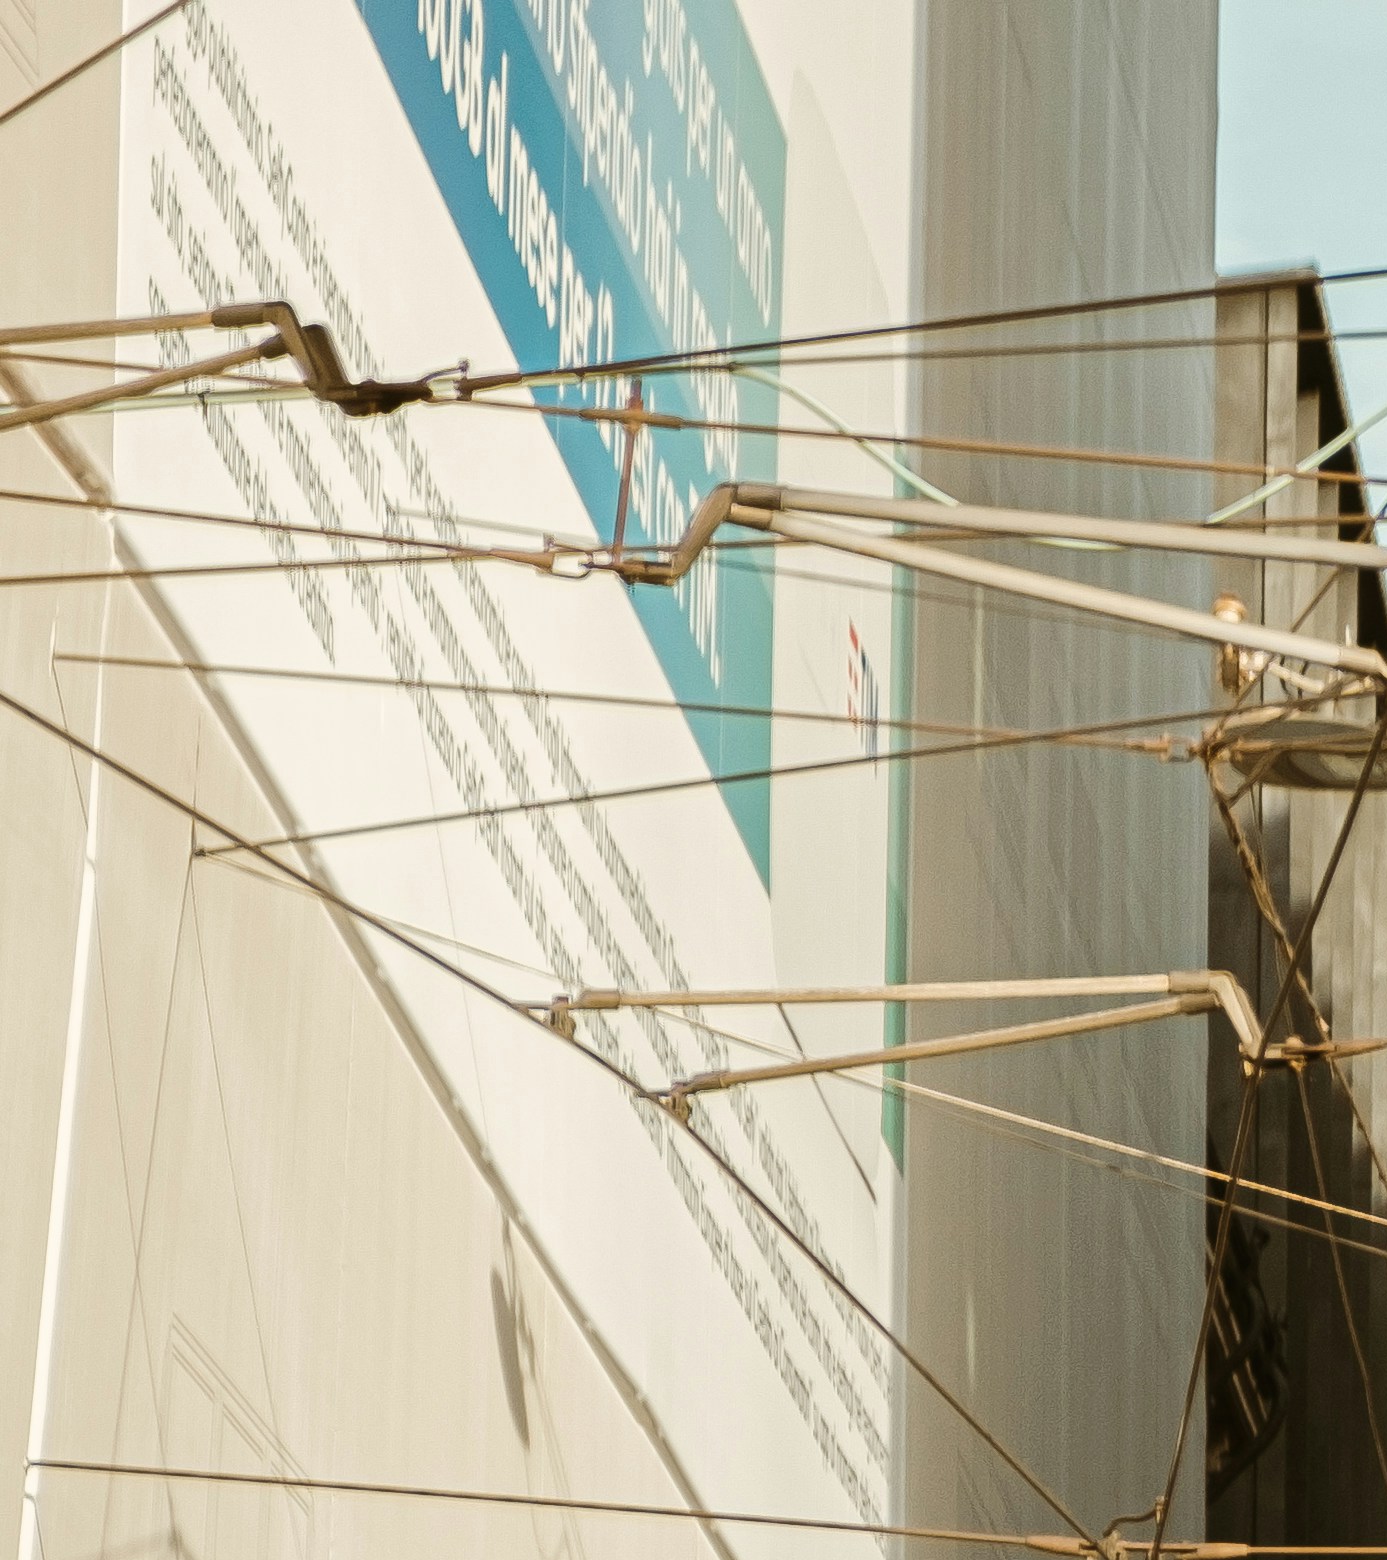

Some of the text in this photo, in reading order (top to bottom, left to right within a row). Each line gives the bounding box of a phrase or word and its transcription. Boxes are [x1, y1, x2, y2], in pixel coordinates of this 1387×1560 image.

[485, 50, 508, 216] al
[508, 124, 557, 330] mese
[559, 239, 593, 401] per
[567, 0, 641, 255] stipendio
[645, 132, 671, 327] hai
[686, 36, 716, 181] per
[716, 105, 735, 240] un
[737, 160, 773, 329] anno
